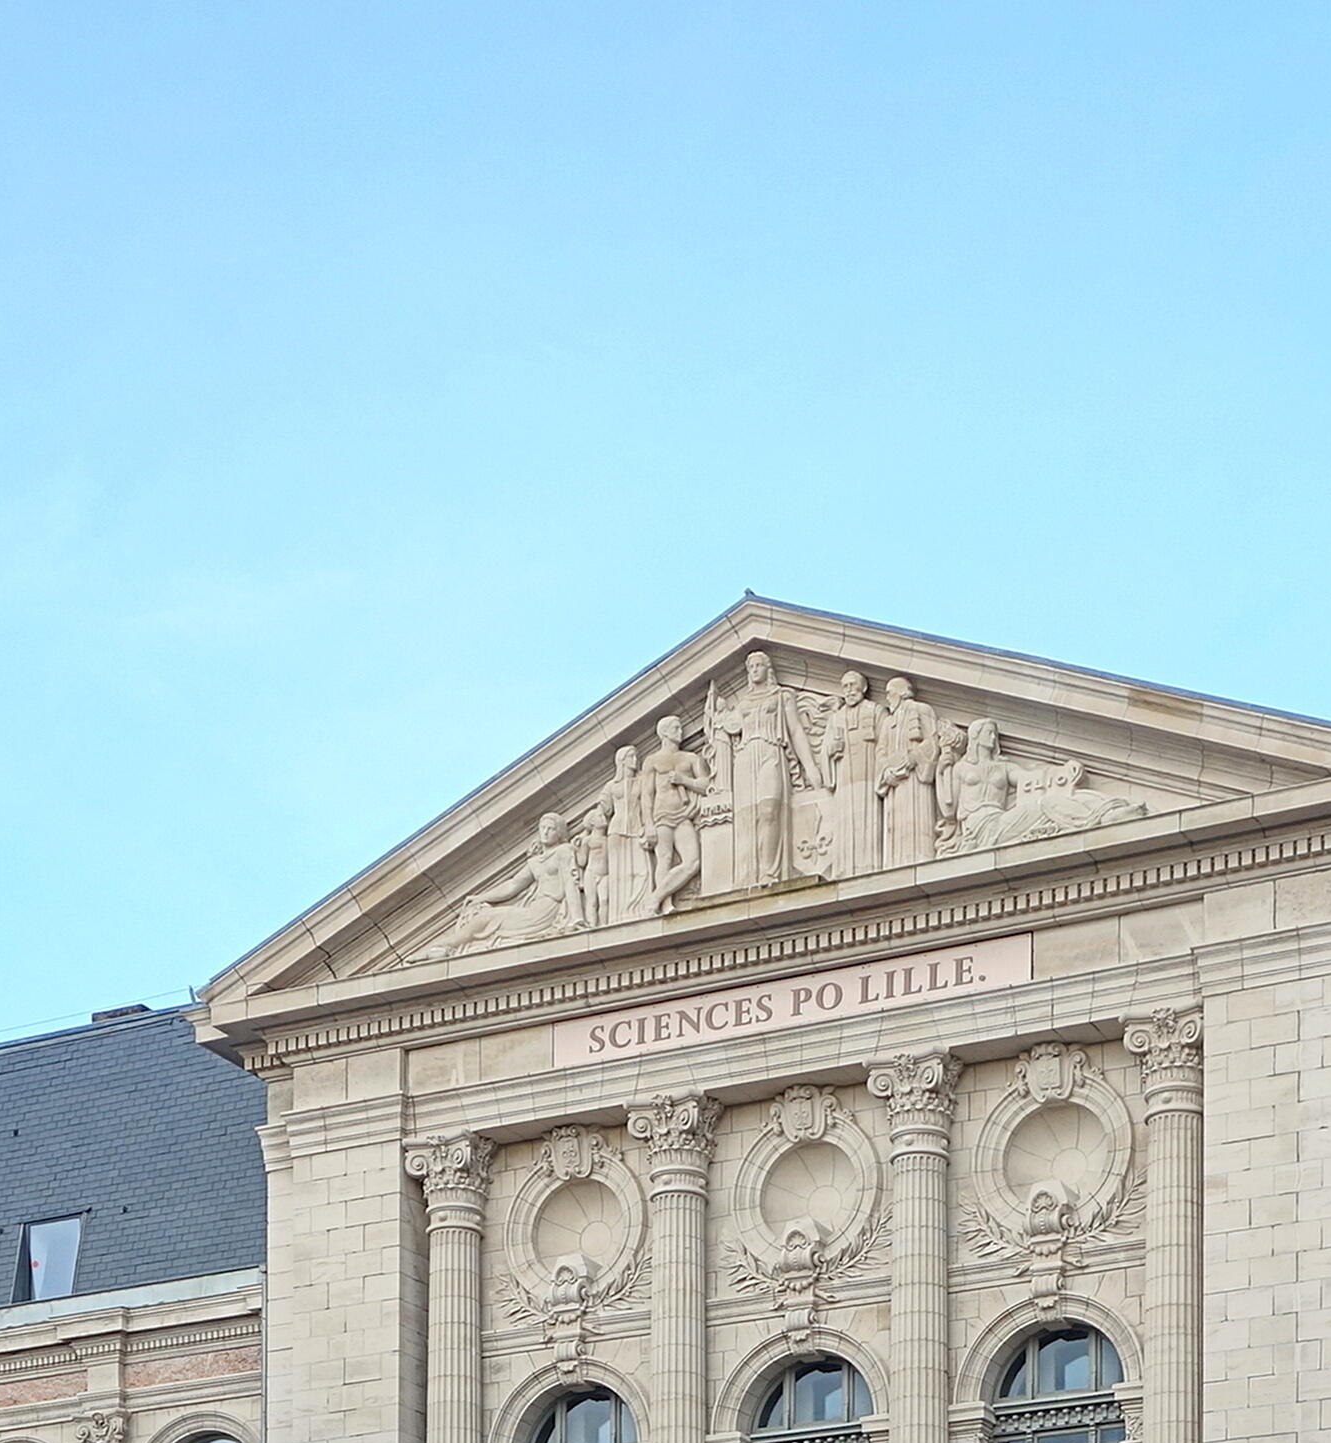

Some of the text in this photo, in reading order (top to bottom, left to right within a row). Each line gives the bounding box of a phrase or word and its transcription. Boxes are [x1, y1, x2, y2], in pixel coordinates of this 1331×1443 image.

[588, 956, 987, 1054] SCIENCES PO LILLE.
